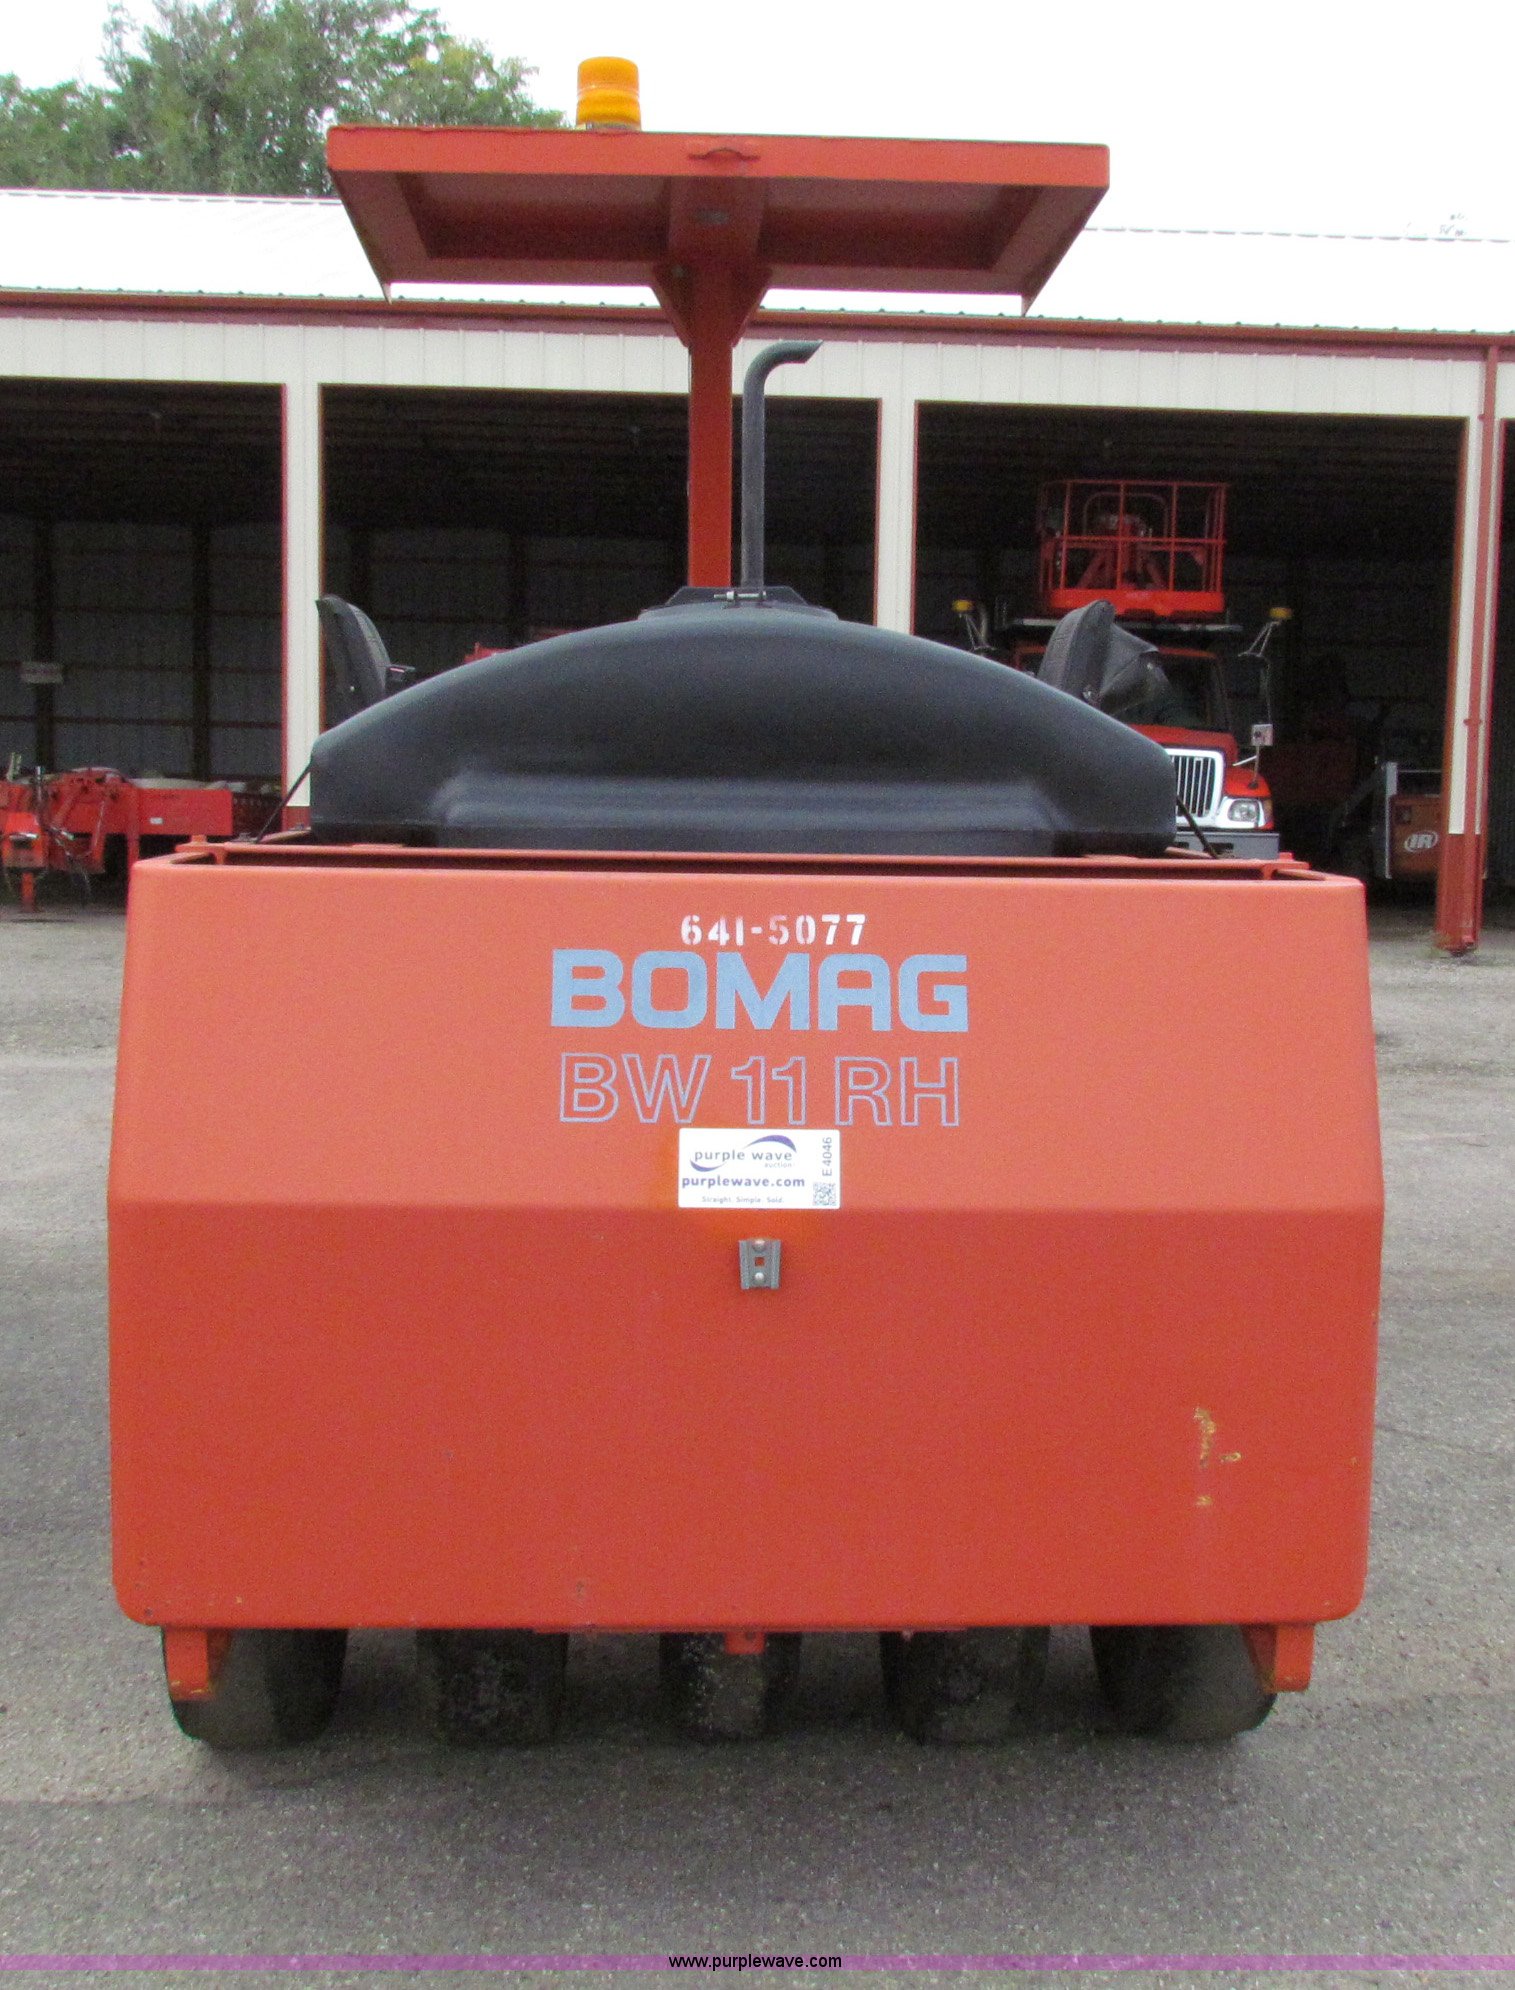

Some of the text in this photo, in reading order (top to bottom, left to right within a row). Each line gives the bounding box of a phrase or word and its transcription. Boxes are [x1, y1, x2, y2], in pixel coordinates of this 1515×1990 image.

[680, 913, 866, 946] 641-5077
[551, 948, 969, 1033] BOMAG
[559, 1052, 960, 1127] BW 11 RH
[694, 1149, 792, 1162] purple wave
[822, 1137, 832, 1176] E 4046
[682, 1175, 805, 1189] purplewave.com
